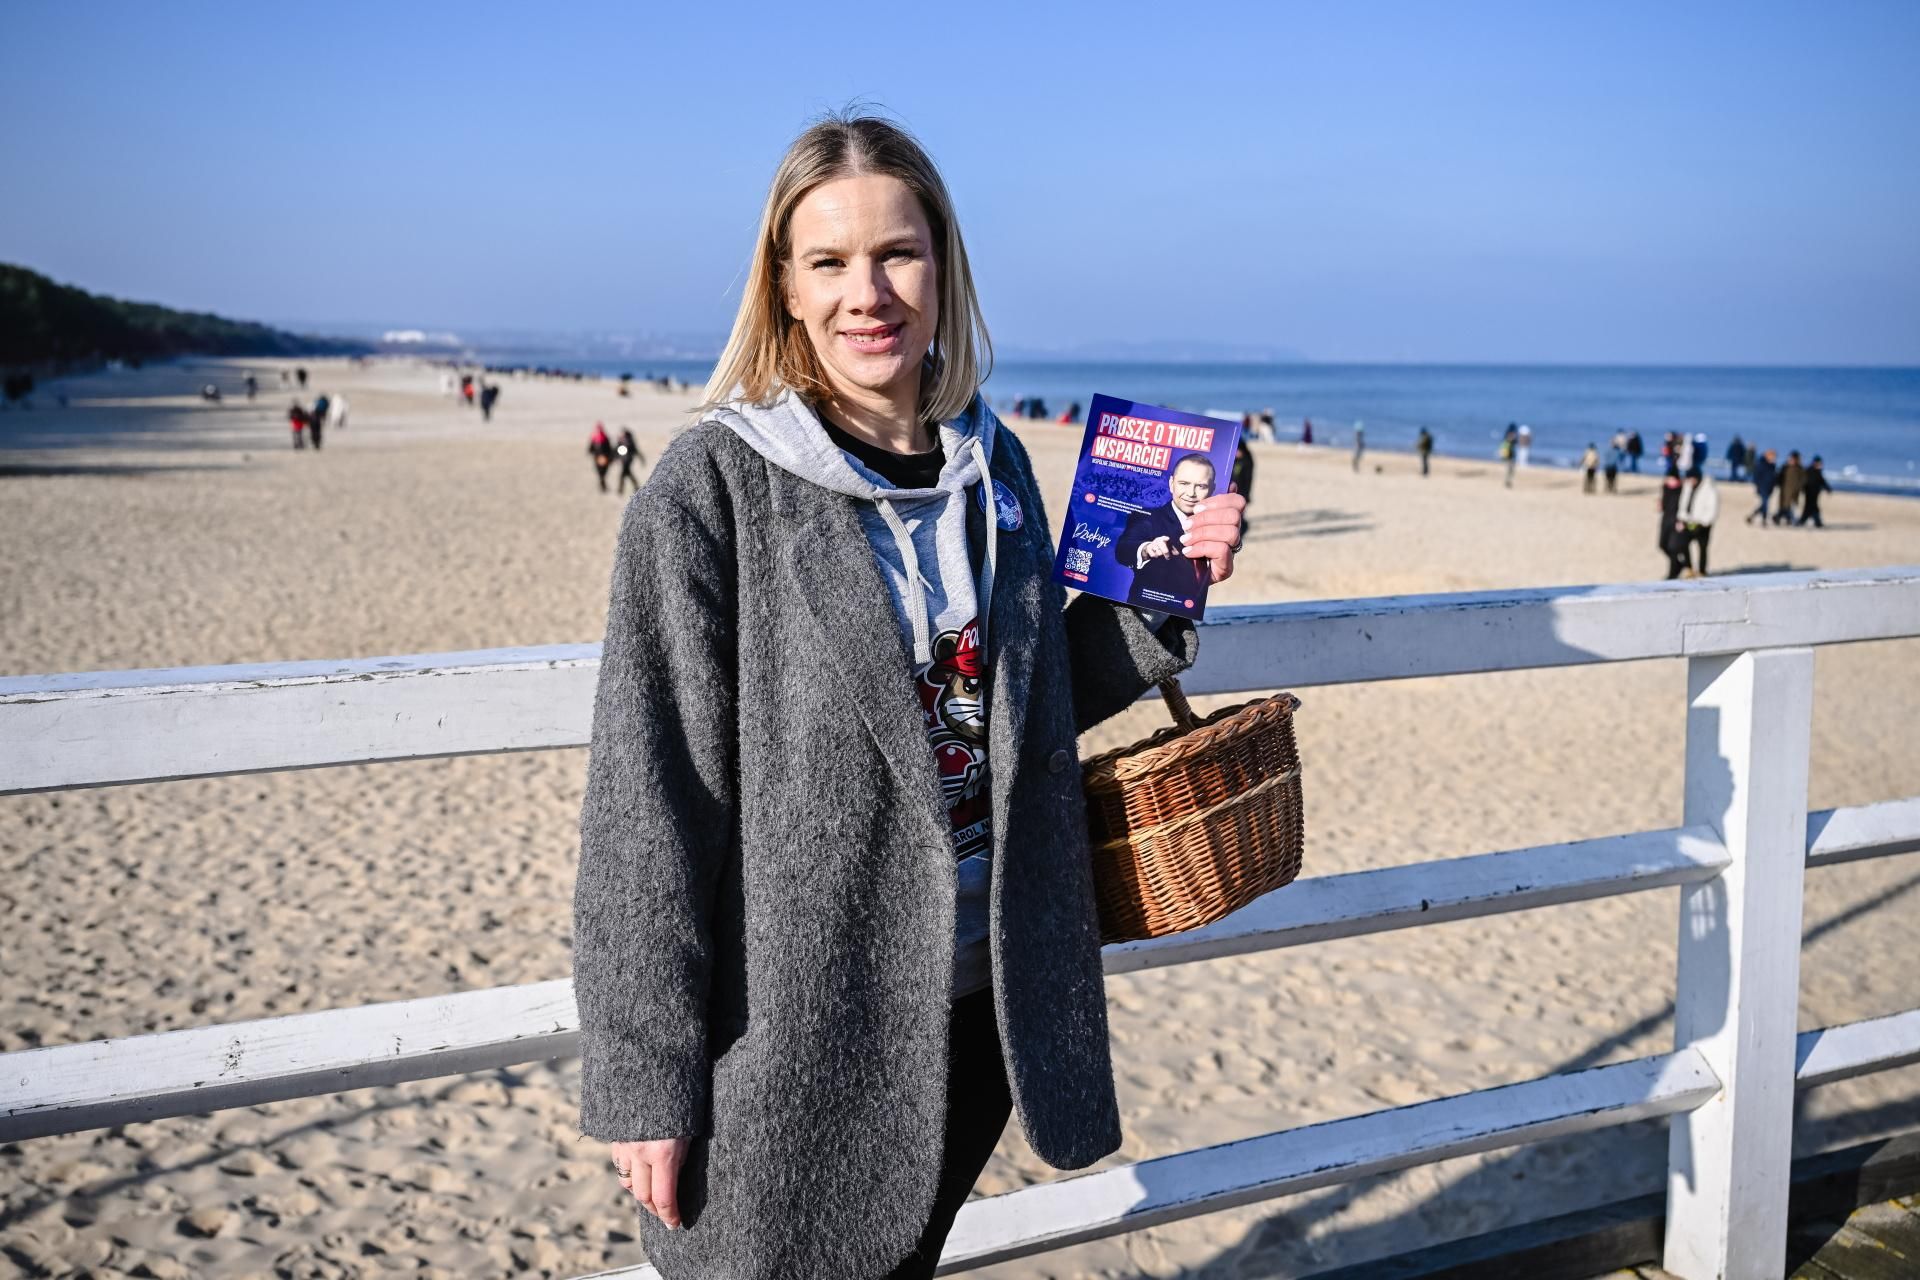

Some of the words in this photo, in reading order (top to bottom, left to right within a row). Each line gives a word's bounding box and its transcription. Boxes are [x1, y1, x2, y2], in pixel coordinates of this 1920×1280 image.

[1100, 414, 1153, 444] PROSZĘ
[1154, 424, 1164, 444] O
[1168, 426, 1212, 450] TWOJE
[1094, 436, 1168, 468] WSPARCIE!
[955, 826, 979, 843] AROL
